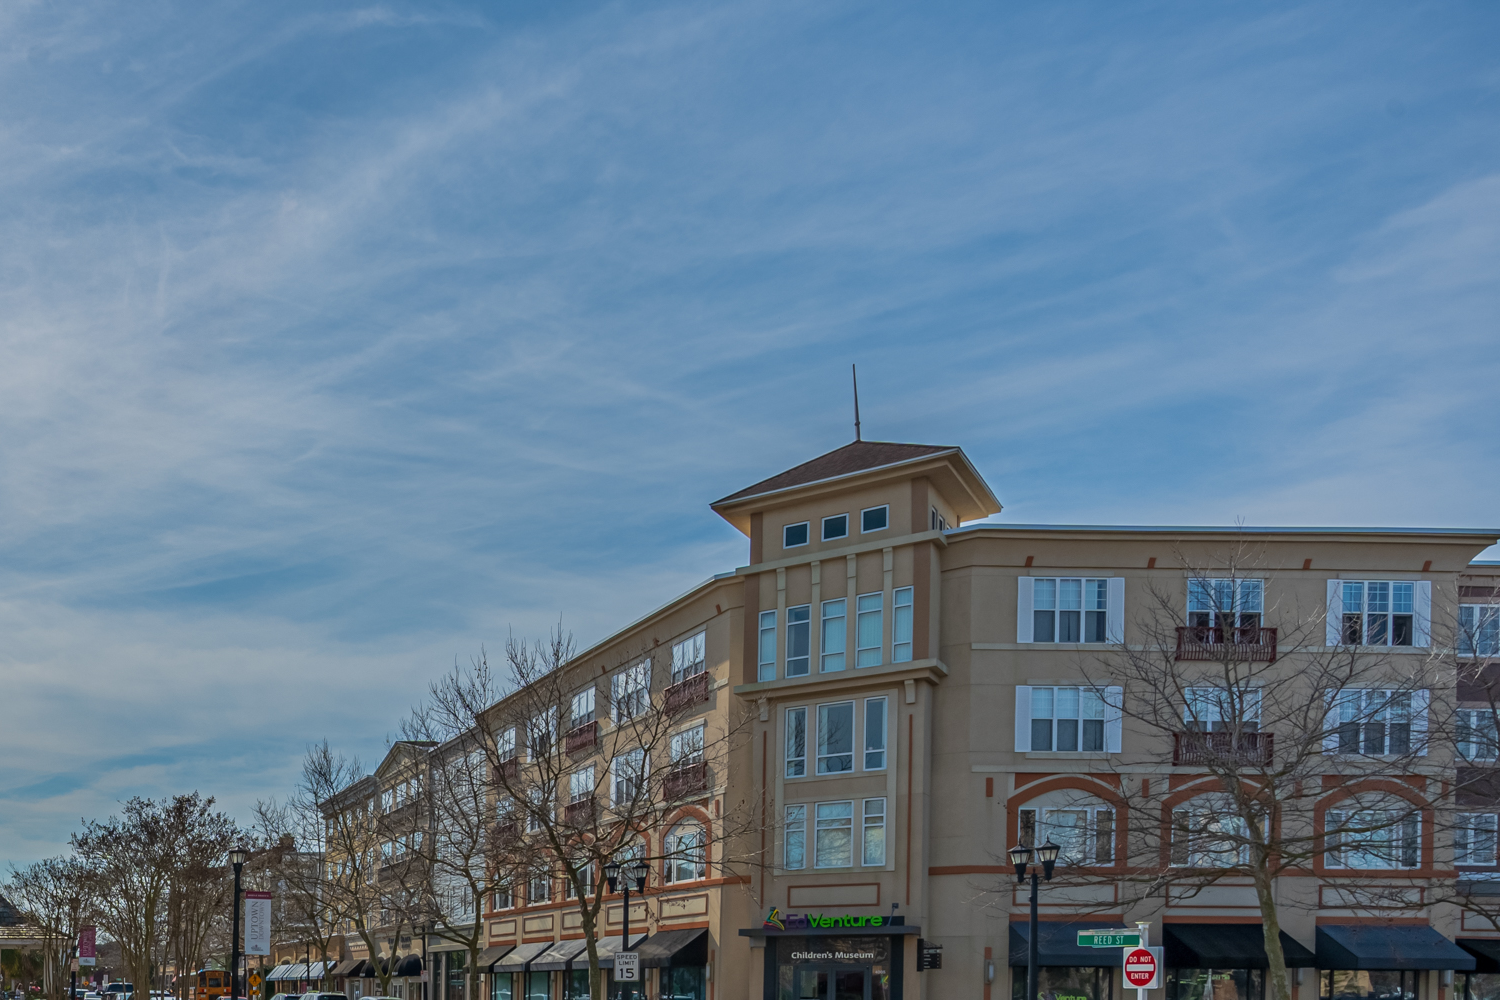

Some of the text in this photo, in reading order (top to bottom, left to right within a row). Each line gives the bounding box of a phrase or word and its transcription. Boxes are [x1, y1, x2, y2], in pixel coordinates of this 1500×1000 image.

[786, 913, 882, 928] EdVenture
[1094, 936, 1124, 944] REED ST
[791, 951, 874, 959] Children's Museum
[620, 968, 634, 978] 15
